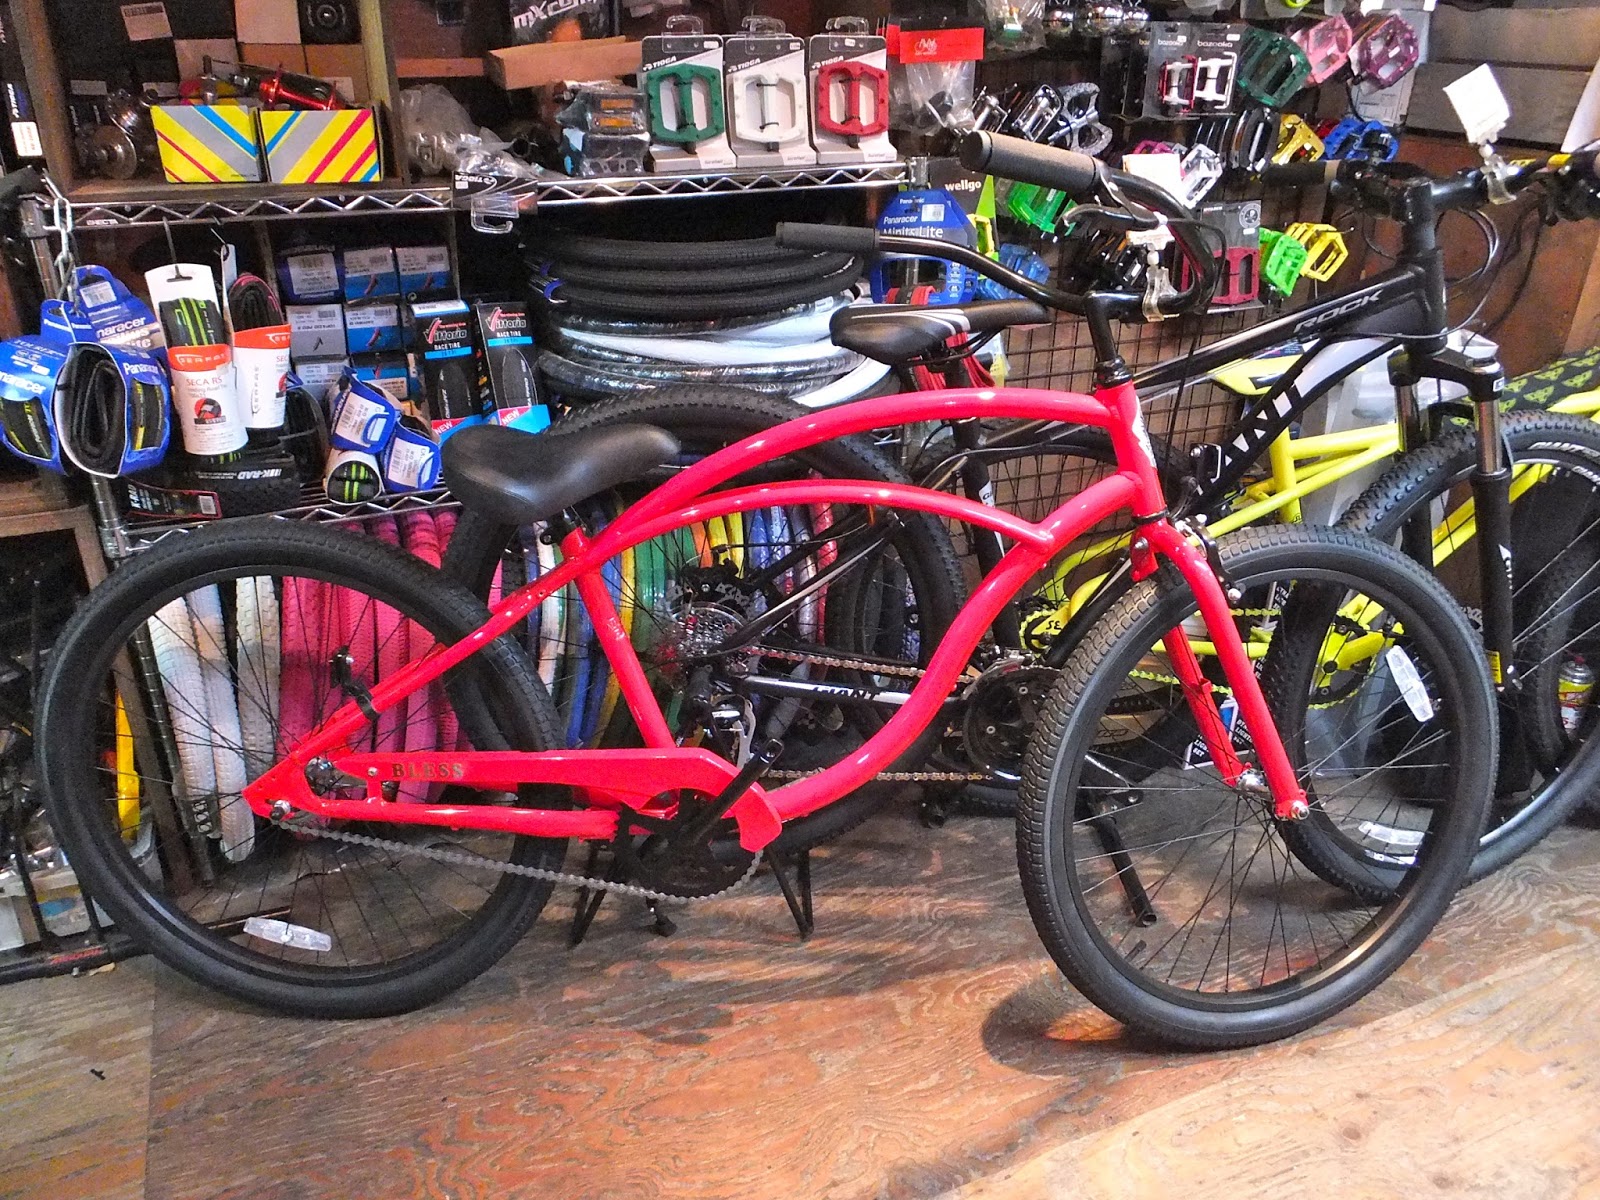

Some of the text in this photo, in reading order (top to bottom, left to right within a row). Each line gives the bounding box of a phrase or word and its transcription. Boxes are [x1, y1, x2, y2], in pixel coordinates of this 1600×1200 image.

[652, 55, 677, 68] TIOGA
[737, 57, 761, 71] TIOGA
[820, 55, 844, 68] TIOGA
[944, 179, 982, 192] wellgo
[1293, 289, 1384, 333] ROCK
[96, 317, 146, 338] naracer
[502, 409, 520, 424] NEW
[434, 420, 453, 435] NEW
[1046, 620, 1062, 630] SE
[392, 762, 465, 779] BLESS
